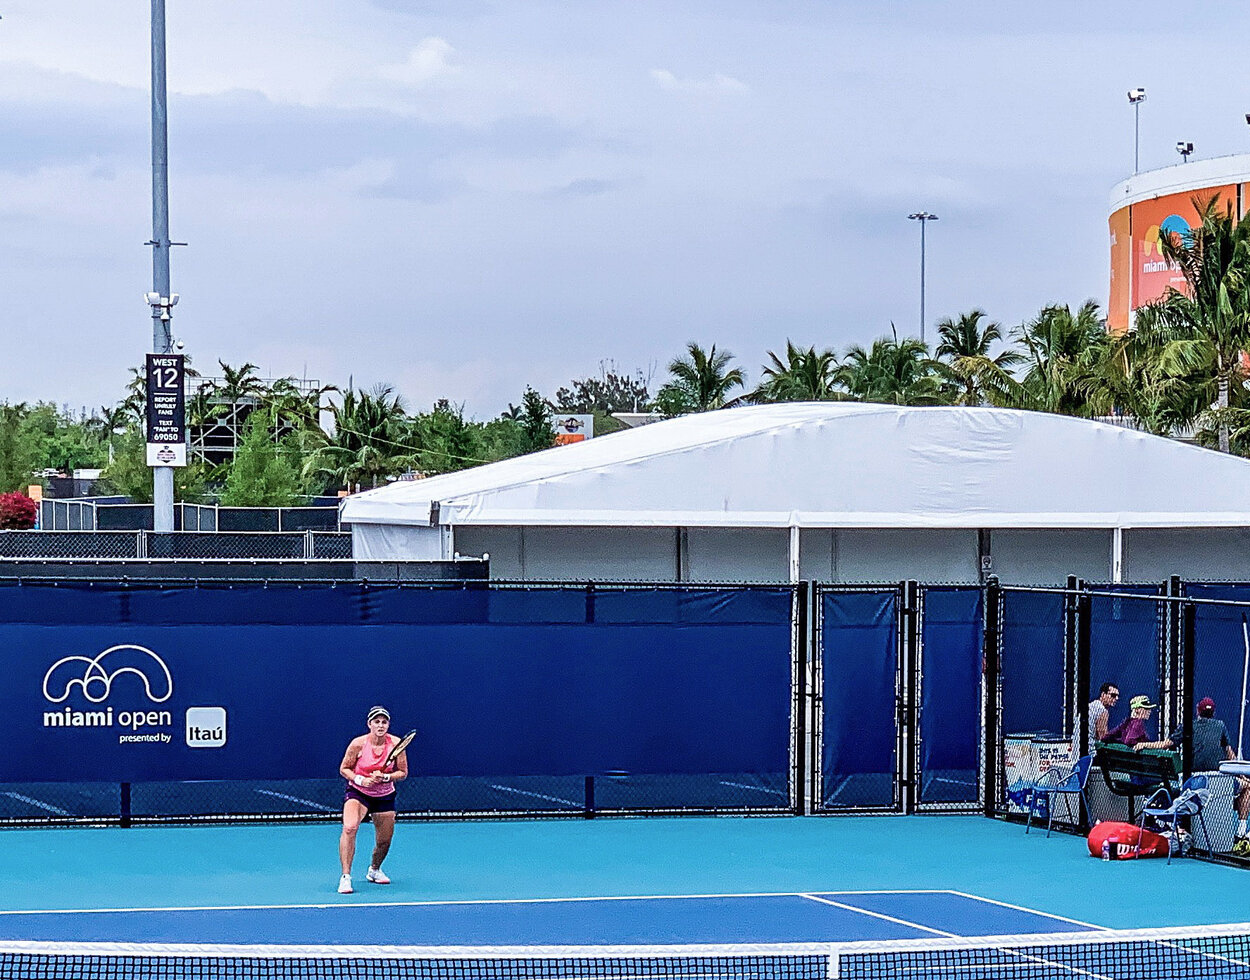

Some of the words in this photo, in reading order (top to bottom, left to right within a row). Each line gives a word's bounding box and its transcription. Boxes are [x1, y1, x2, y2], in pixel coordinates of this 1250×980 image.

[153, 358, 178, 366] WEST
[153, 367, 178, 388] 12
[154, 433, 178, 441] 69050
[43, 707, 113, 726] miami
[118, 711, 172, 730] open
[119, 732, 160, 744] presented
[160, 732, 172, 743] by
[189, 727, 223, 741] Itaú
